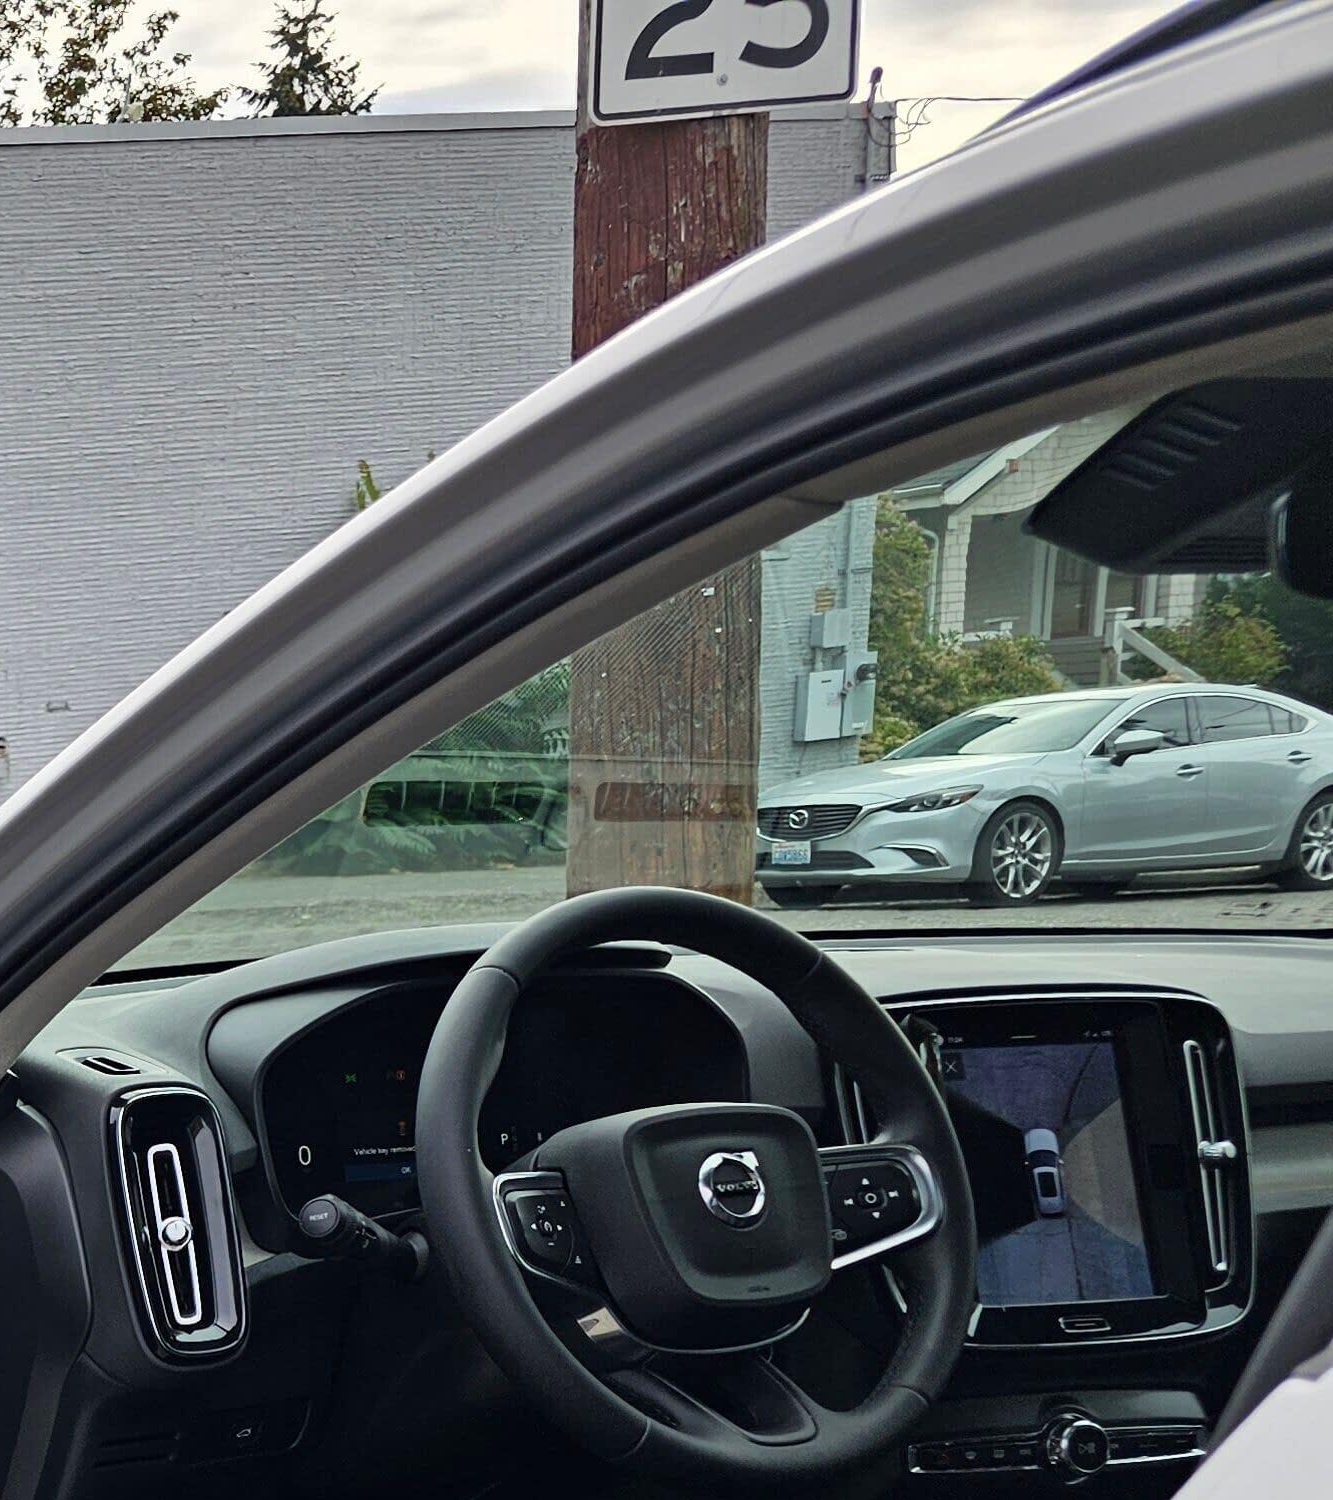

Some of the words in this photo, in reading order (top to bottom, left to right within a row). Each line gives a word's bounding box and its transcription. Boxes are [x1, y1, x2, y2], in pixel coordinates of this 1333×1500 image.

[500, 1133, 509, 1145] P
[298, 1145, 312, 1166] 0
[353, 1147, 377, 1156] Vehicle
[309, 1213, 329, 1221] RESET
